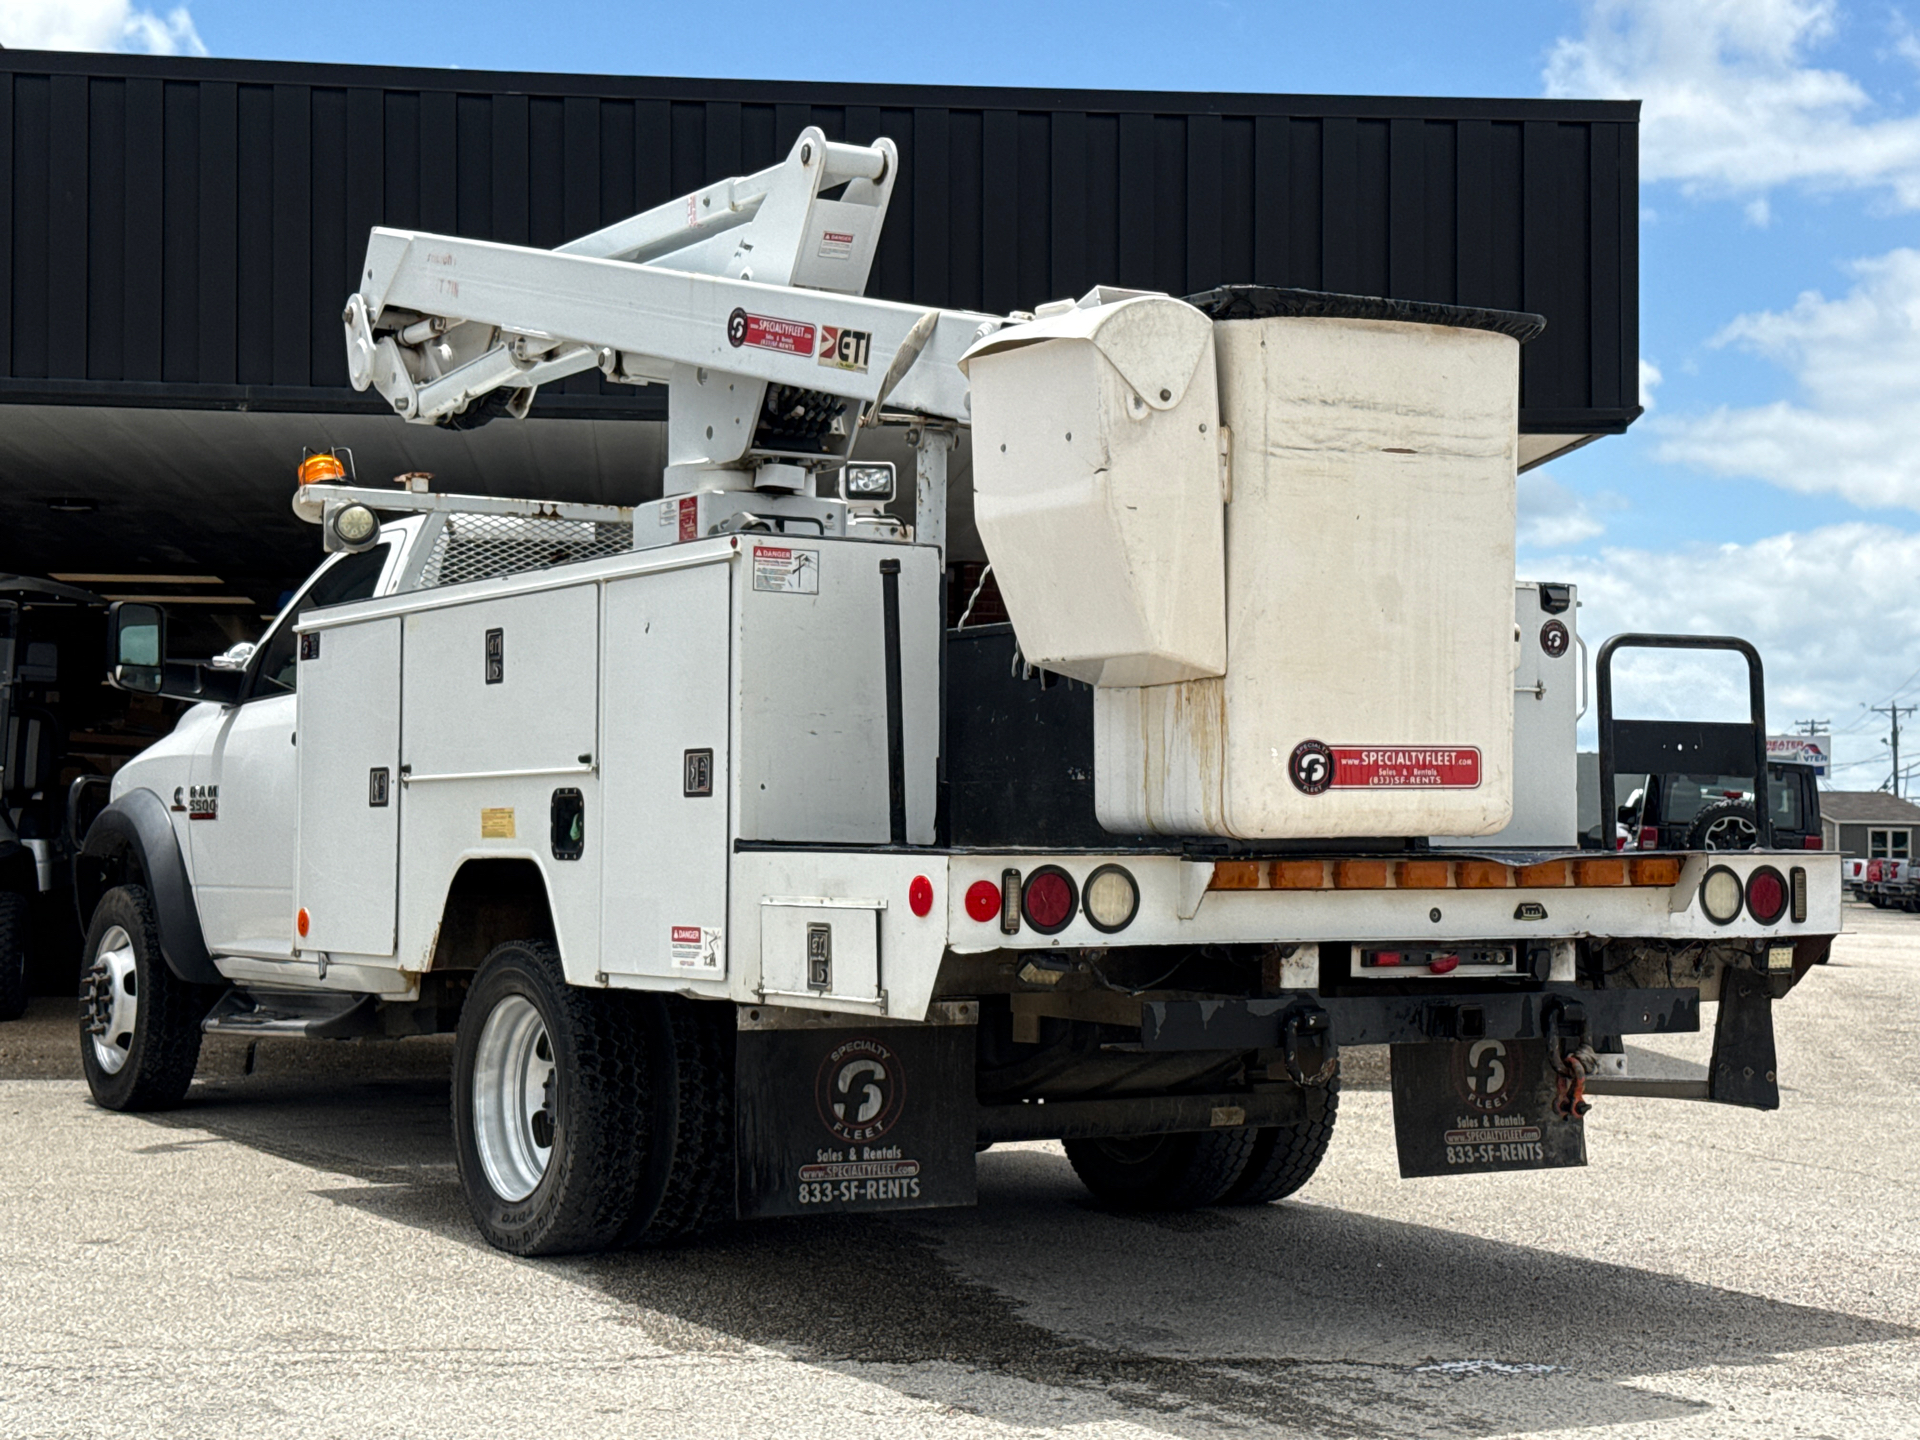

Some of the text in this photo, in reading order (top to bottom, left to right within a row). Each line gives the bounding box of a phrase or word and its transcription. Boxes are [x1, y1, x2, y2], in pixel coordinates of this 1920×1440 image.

[837, 329, 871, 366] ETI
[763, 550, 791, 558] DANGER
[1378, 768, 1437, 776] Sales & Rentals
[190, 785, 218, 798] RAM
[190, 799, 217, 811] 5500
[678, 930, 700, 939] DANGER
[830, 1040, 891, 1062] SPECIALTY
[1468, 1091, 1508, 1109] FLEET
[1457, 1113, 1525, 1128] Sales & Rentals
[833, 1120, 884, 1140] FLEET
[1448, 1129, 1538, 1142] www.SPECIALTYFLEET.com
[817, 1145, 902, 1162] Sales & Rentals
[1446, 1143, 1544, 1165] 833-SF-RENTS
[803, 1163, 916, 1179] www.SPECIALTYFLEET.com
[798, 1178, 920, 1203] 833-SF-RENTS
